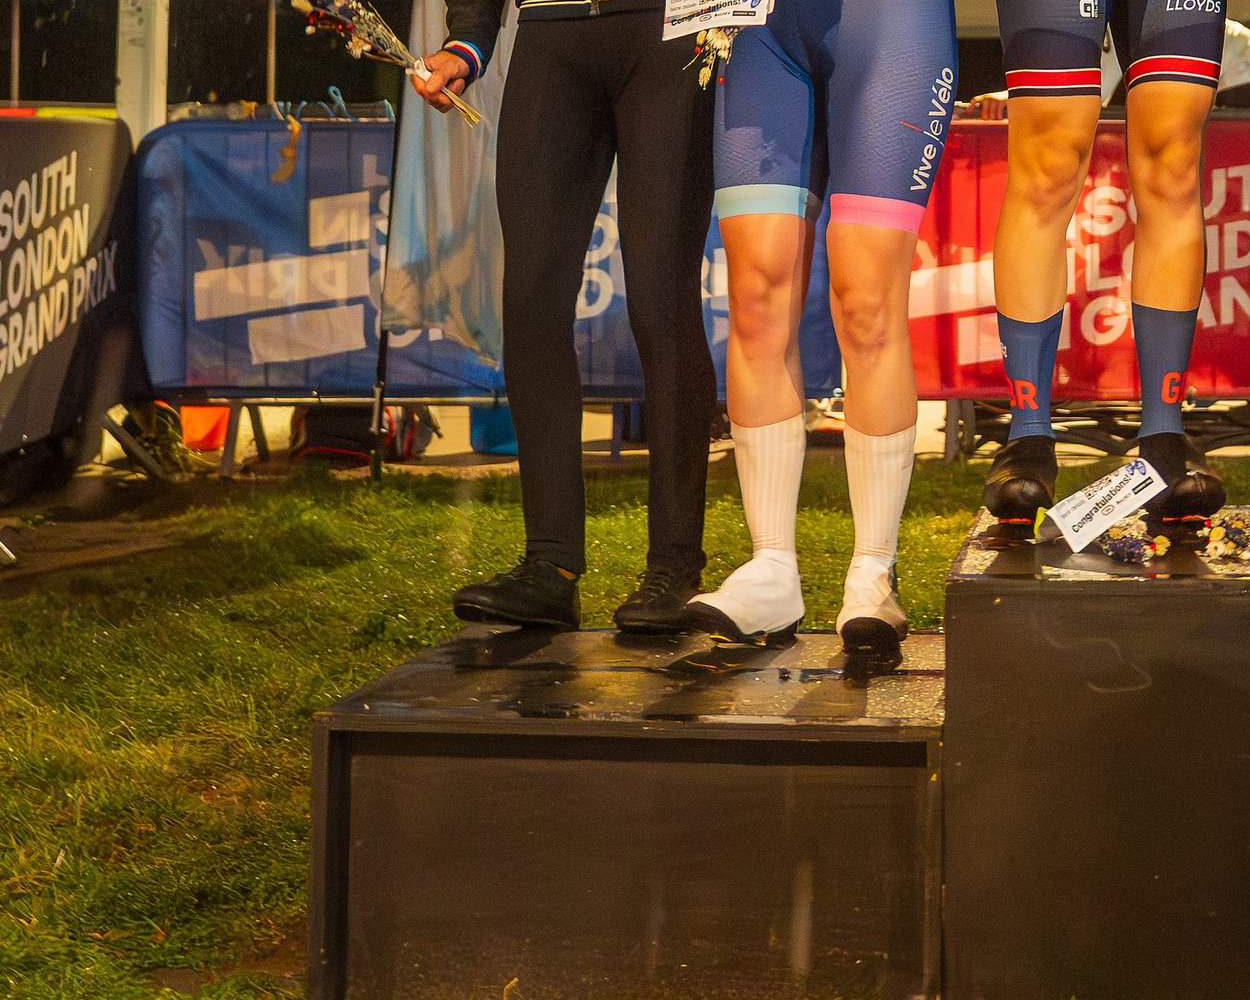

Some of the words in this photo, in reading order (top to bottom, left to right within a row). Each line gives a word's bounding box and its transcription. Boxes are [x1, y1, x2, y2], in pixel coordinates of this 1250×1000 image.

[928, 67, 954, 117] Vélo
[923, 119, 943, 147] le
[910, 143, 937, 191] Vive
[0, 150, 78, 250] SOUTH
[71, 240, 118, 324] PRIX
[1071, 474, 1132, 533] Congratulations!
